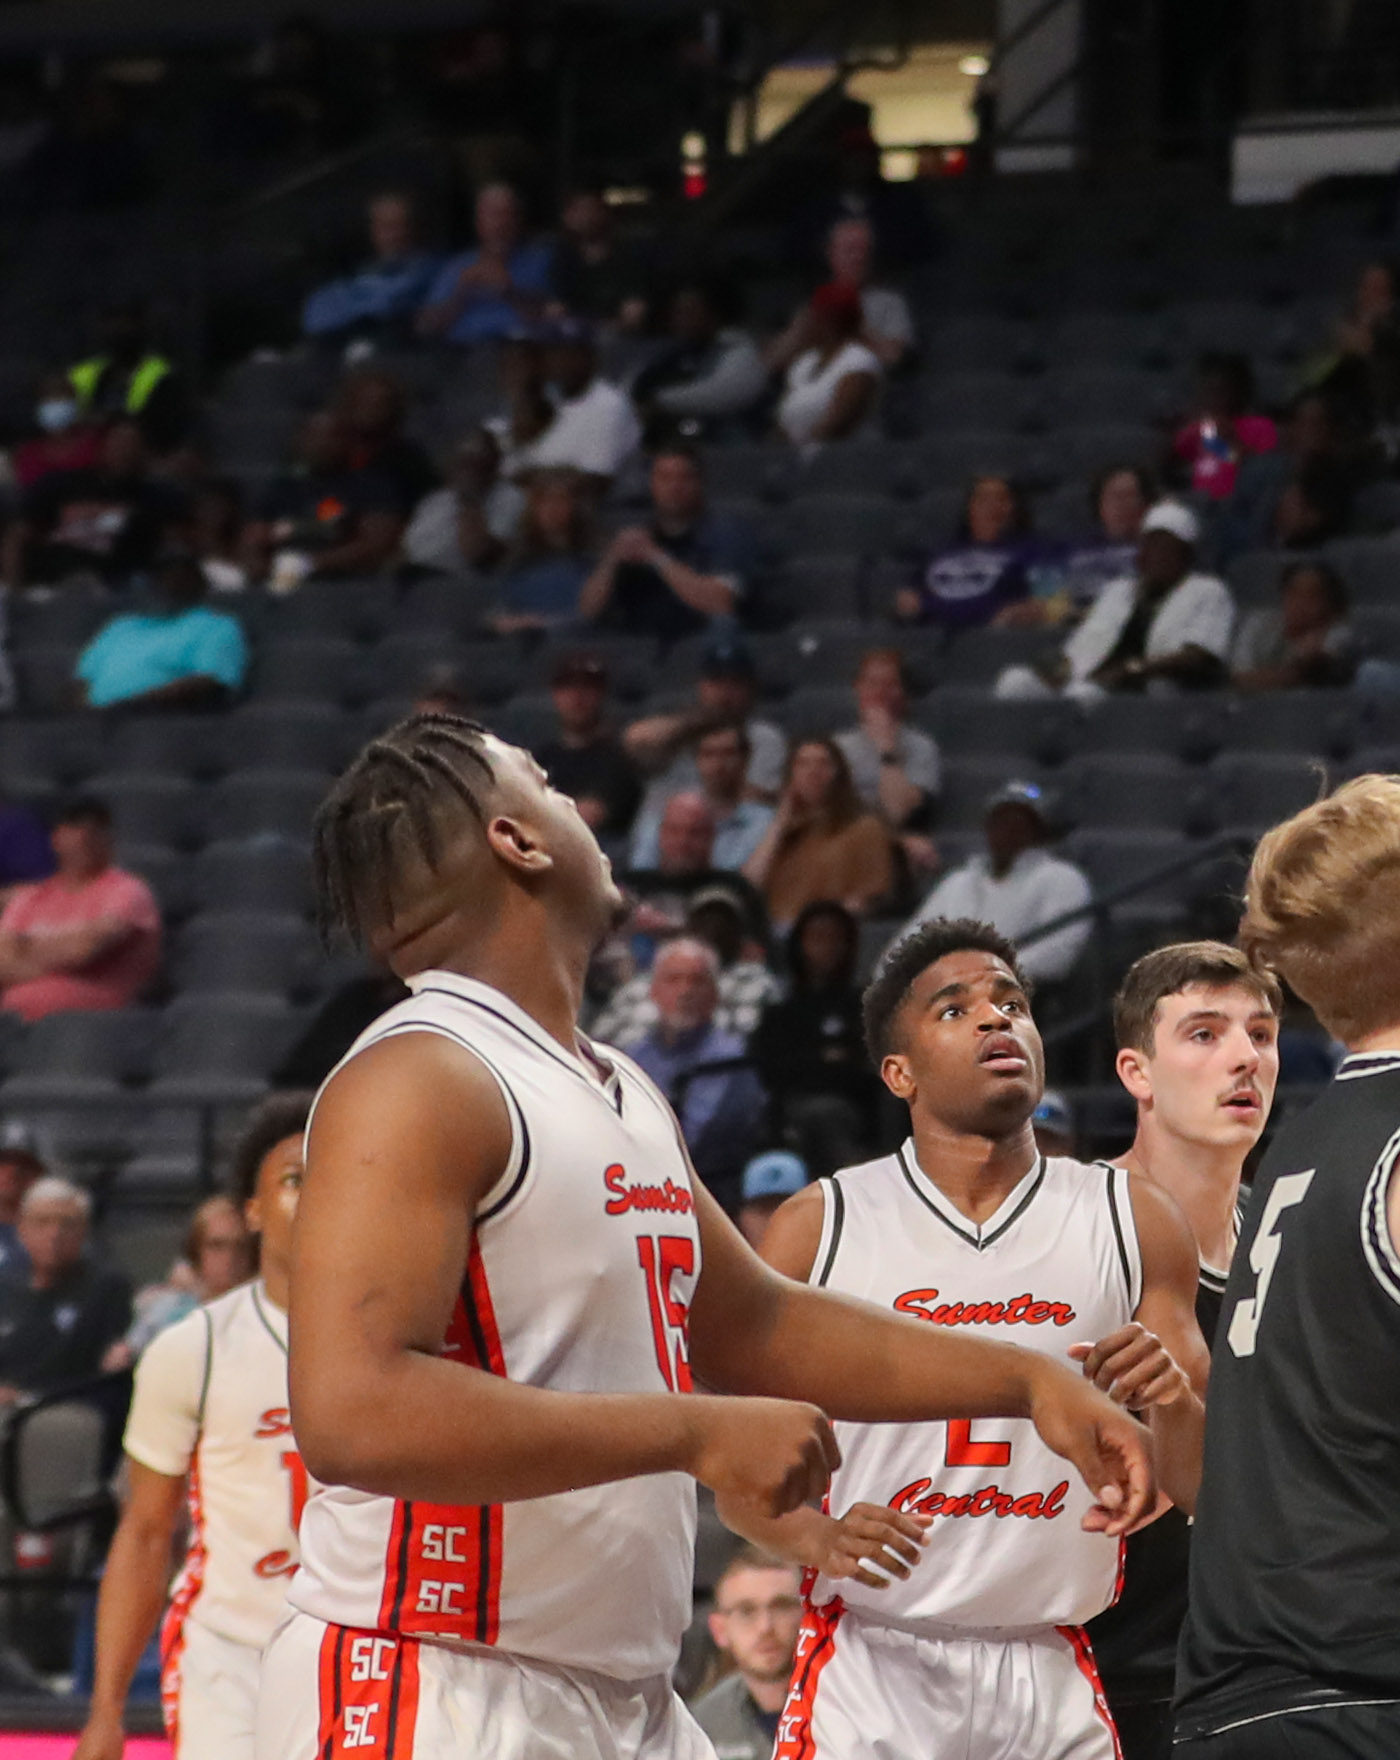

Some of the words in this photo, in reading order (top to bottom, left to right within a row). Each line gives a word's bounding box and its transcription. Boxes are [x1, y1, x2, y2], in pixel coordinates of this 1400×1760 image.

[1227, 1168, 1316, 1358] 5
[636, 1235, 694, 1394] 15
[893, 1288, 1076, 1326] Sumter
[887, 1477, 1070, 1519] Central
[421, 1524, 467, 1563] SC
[415, 1579, 465, 1615] SC
[350, 1637, 396, 1682] SC
[342, 1702, 380, 1748] SC
